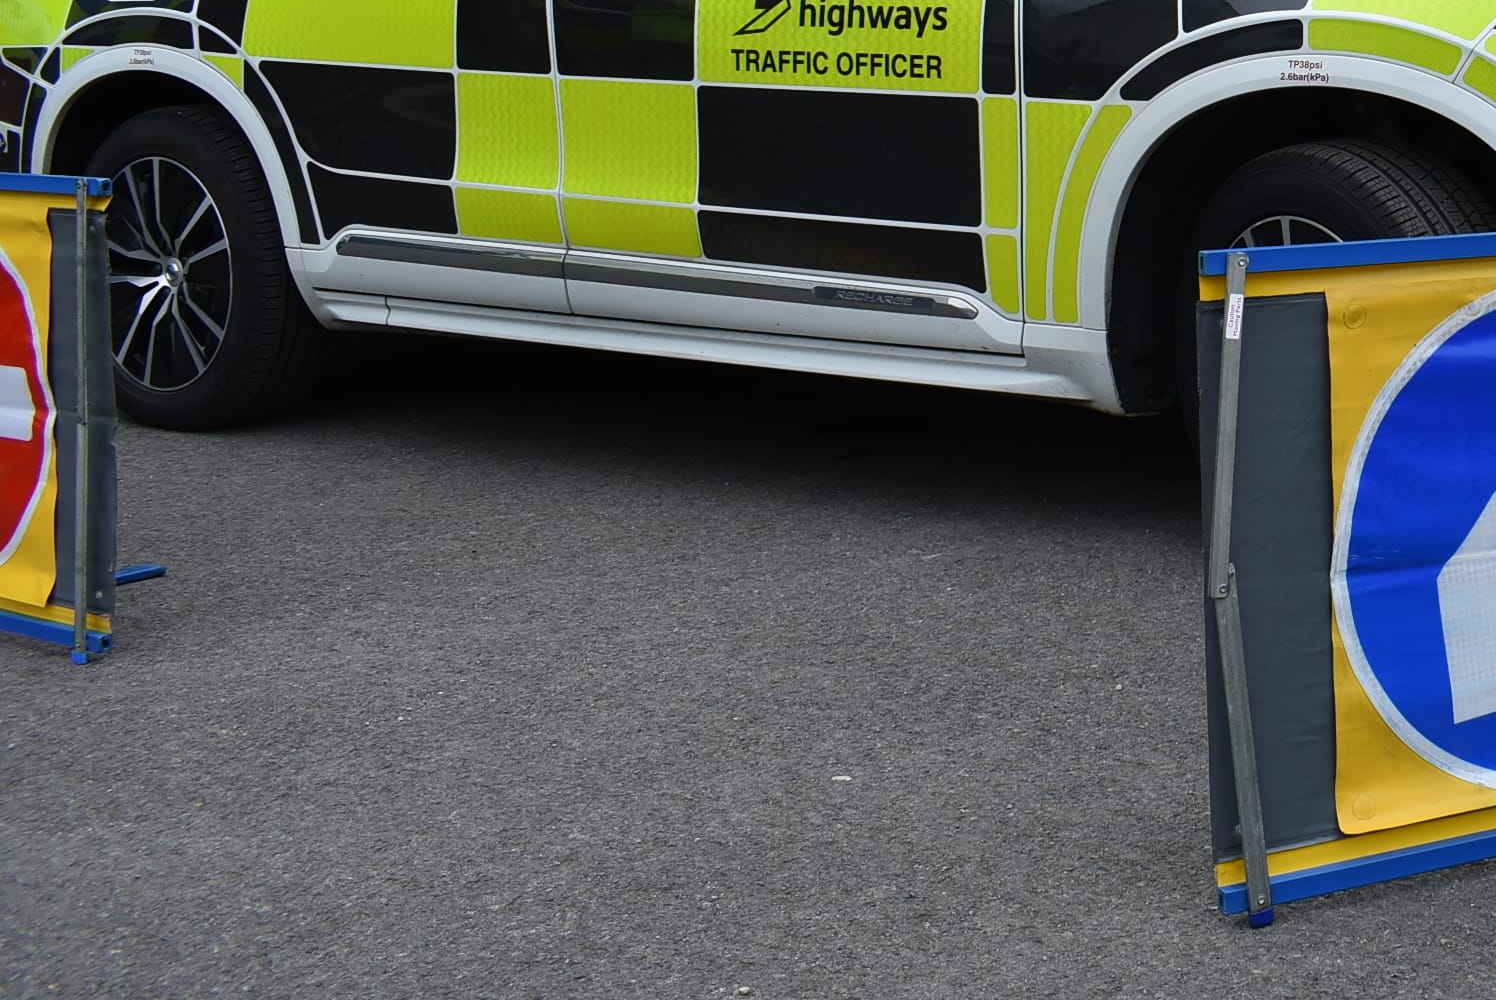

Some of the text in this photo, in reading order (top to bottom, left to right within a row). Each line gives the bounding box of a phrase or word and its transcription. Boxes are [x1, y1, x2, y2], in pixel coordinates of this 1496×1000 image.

[731, 49, 942, 79] TRAFFIC OFFICER
[1288, 60, 1323, 70] TP38psi
[1280, 72, 1329, 83] 2.6bar(kPa)
[834, 290, 913, 306] RECHARGE
[1228, 304, 1236, 328] Caution
[1232, 315, 1241, 337] Moving
